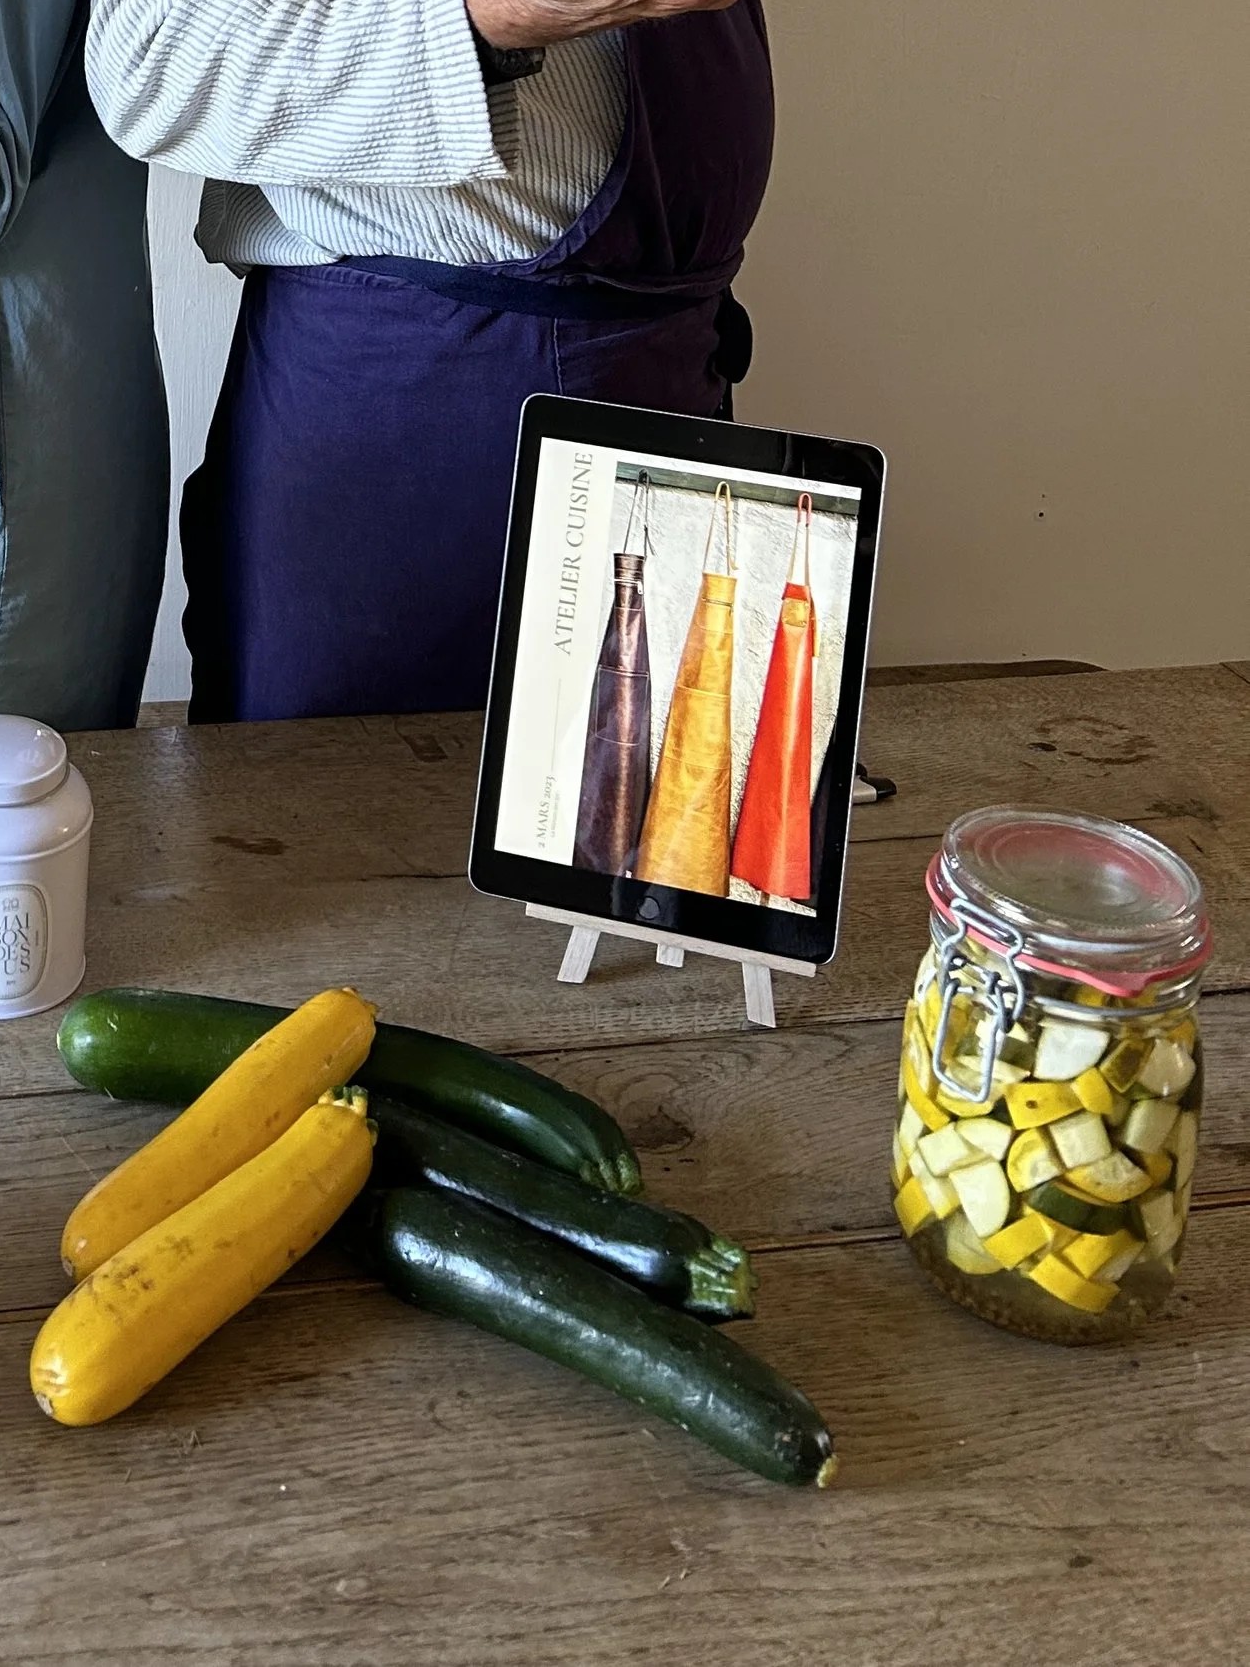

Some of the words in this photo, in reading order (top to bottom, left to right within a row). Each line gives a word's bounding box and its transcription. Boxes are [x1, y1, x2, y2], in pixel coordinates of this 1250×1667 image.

[565, 451, 594, 548] CUISINE
[553, 554, 582, 655] ATELIER
[536, 800, 550, 840] MARS
[543, 774, 558, 799] 2023
